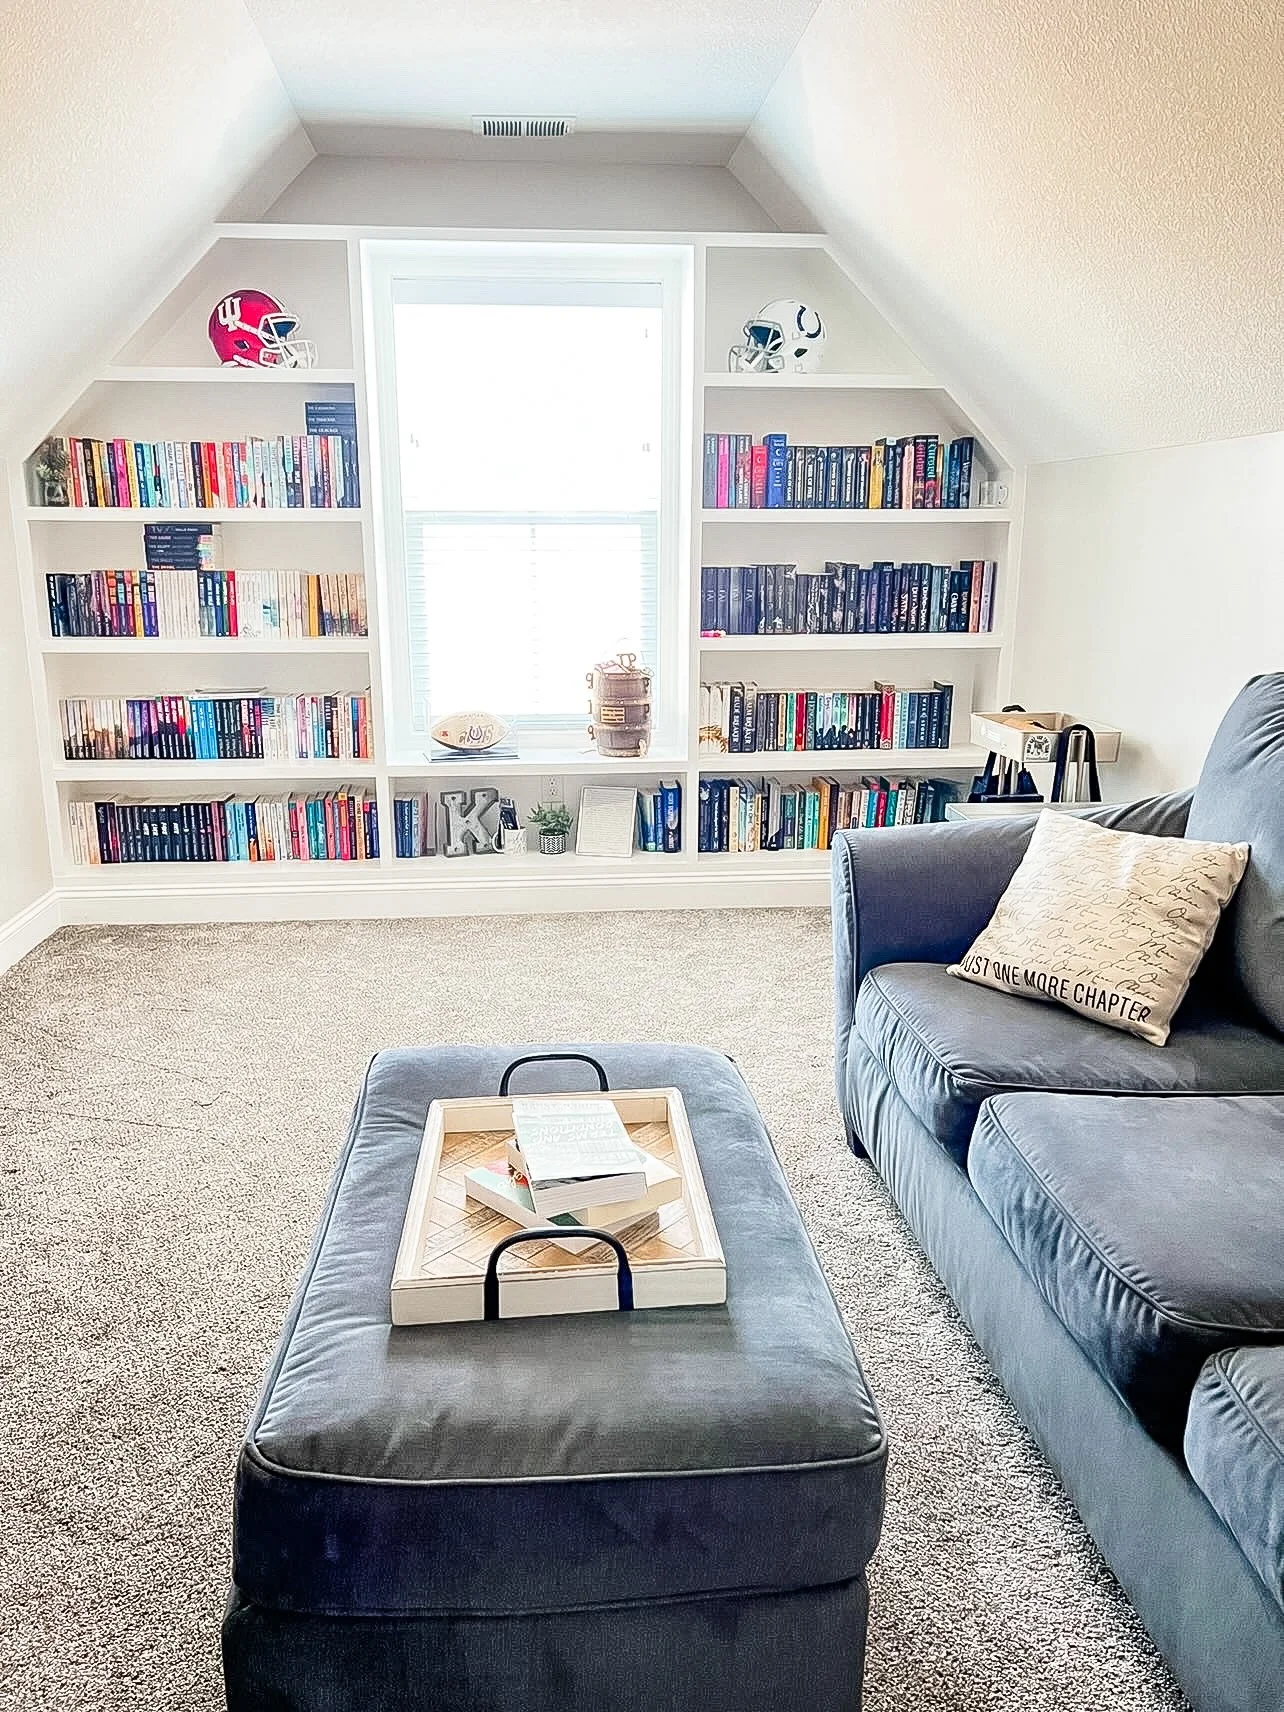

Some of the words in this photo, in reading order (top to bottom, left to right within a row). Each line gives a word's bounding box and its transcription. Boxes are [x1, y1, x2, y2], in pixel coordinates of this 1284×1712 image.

[440, 787, 499, 858] K
[993, 961, 1020, 986] ONE
[1024, 968, 1070, 1000] MORE
[1073, 983, 1152, 1024] CHAPTER
